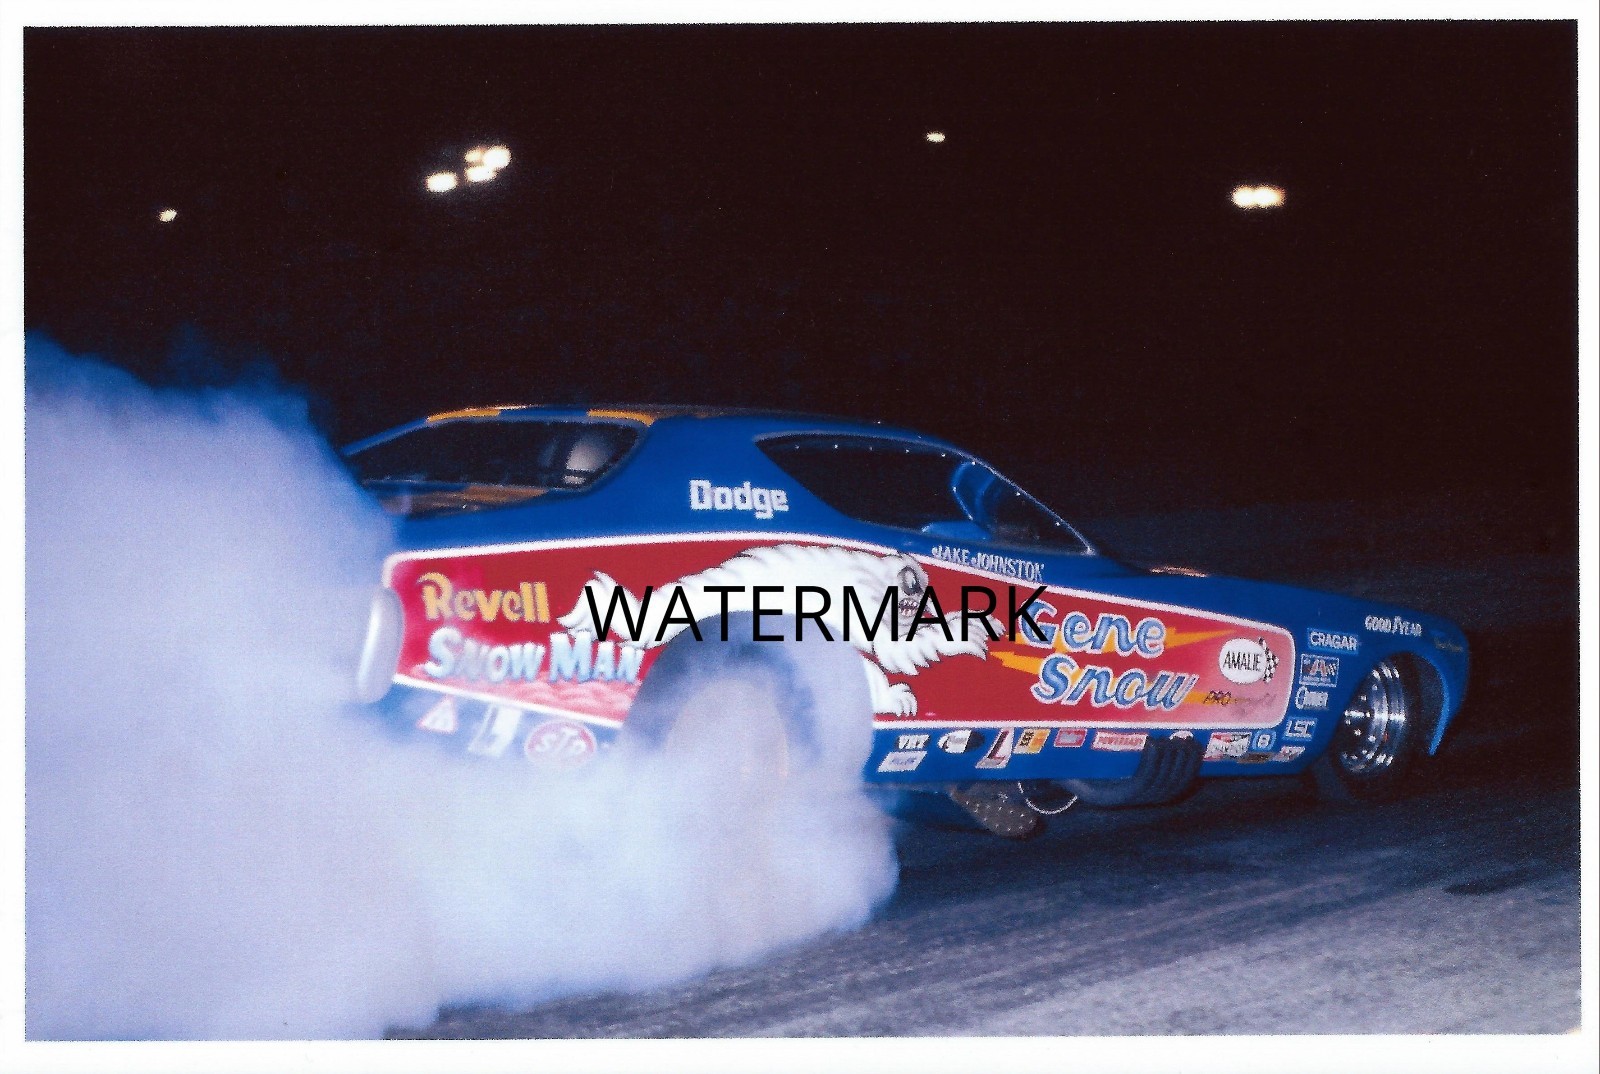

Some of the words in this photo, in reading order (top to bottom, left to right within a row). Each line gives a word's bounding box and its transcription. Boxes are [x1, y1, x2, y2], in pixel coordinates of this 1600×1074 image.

[689, 479, 790, 519] Dodge
[931, 545, 970, 567] JAKE
[417, 572, 551, 623] Revell
[1018, 598, 1167, 658] Gene
[1310, 632, 1358, 650] CRAGAR
[1223, 650, 1262, 672] AMALIE
[1030, 653, 1199, 710] Snow
[534, 726, 587, 756] STP
